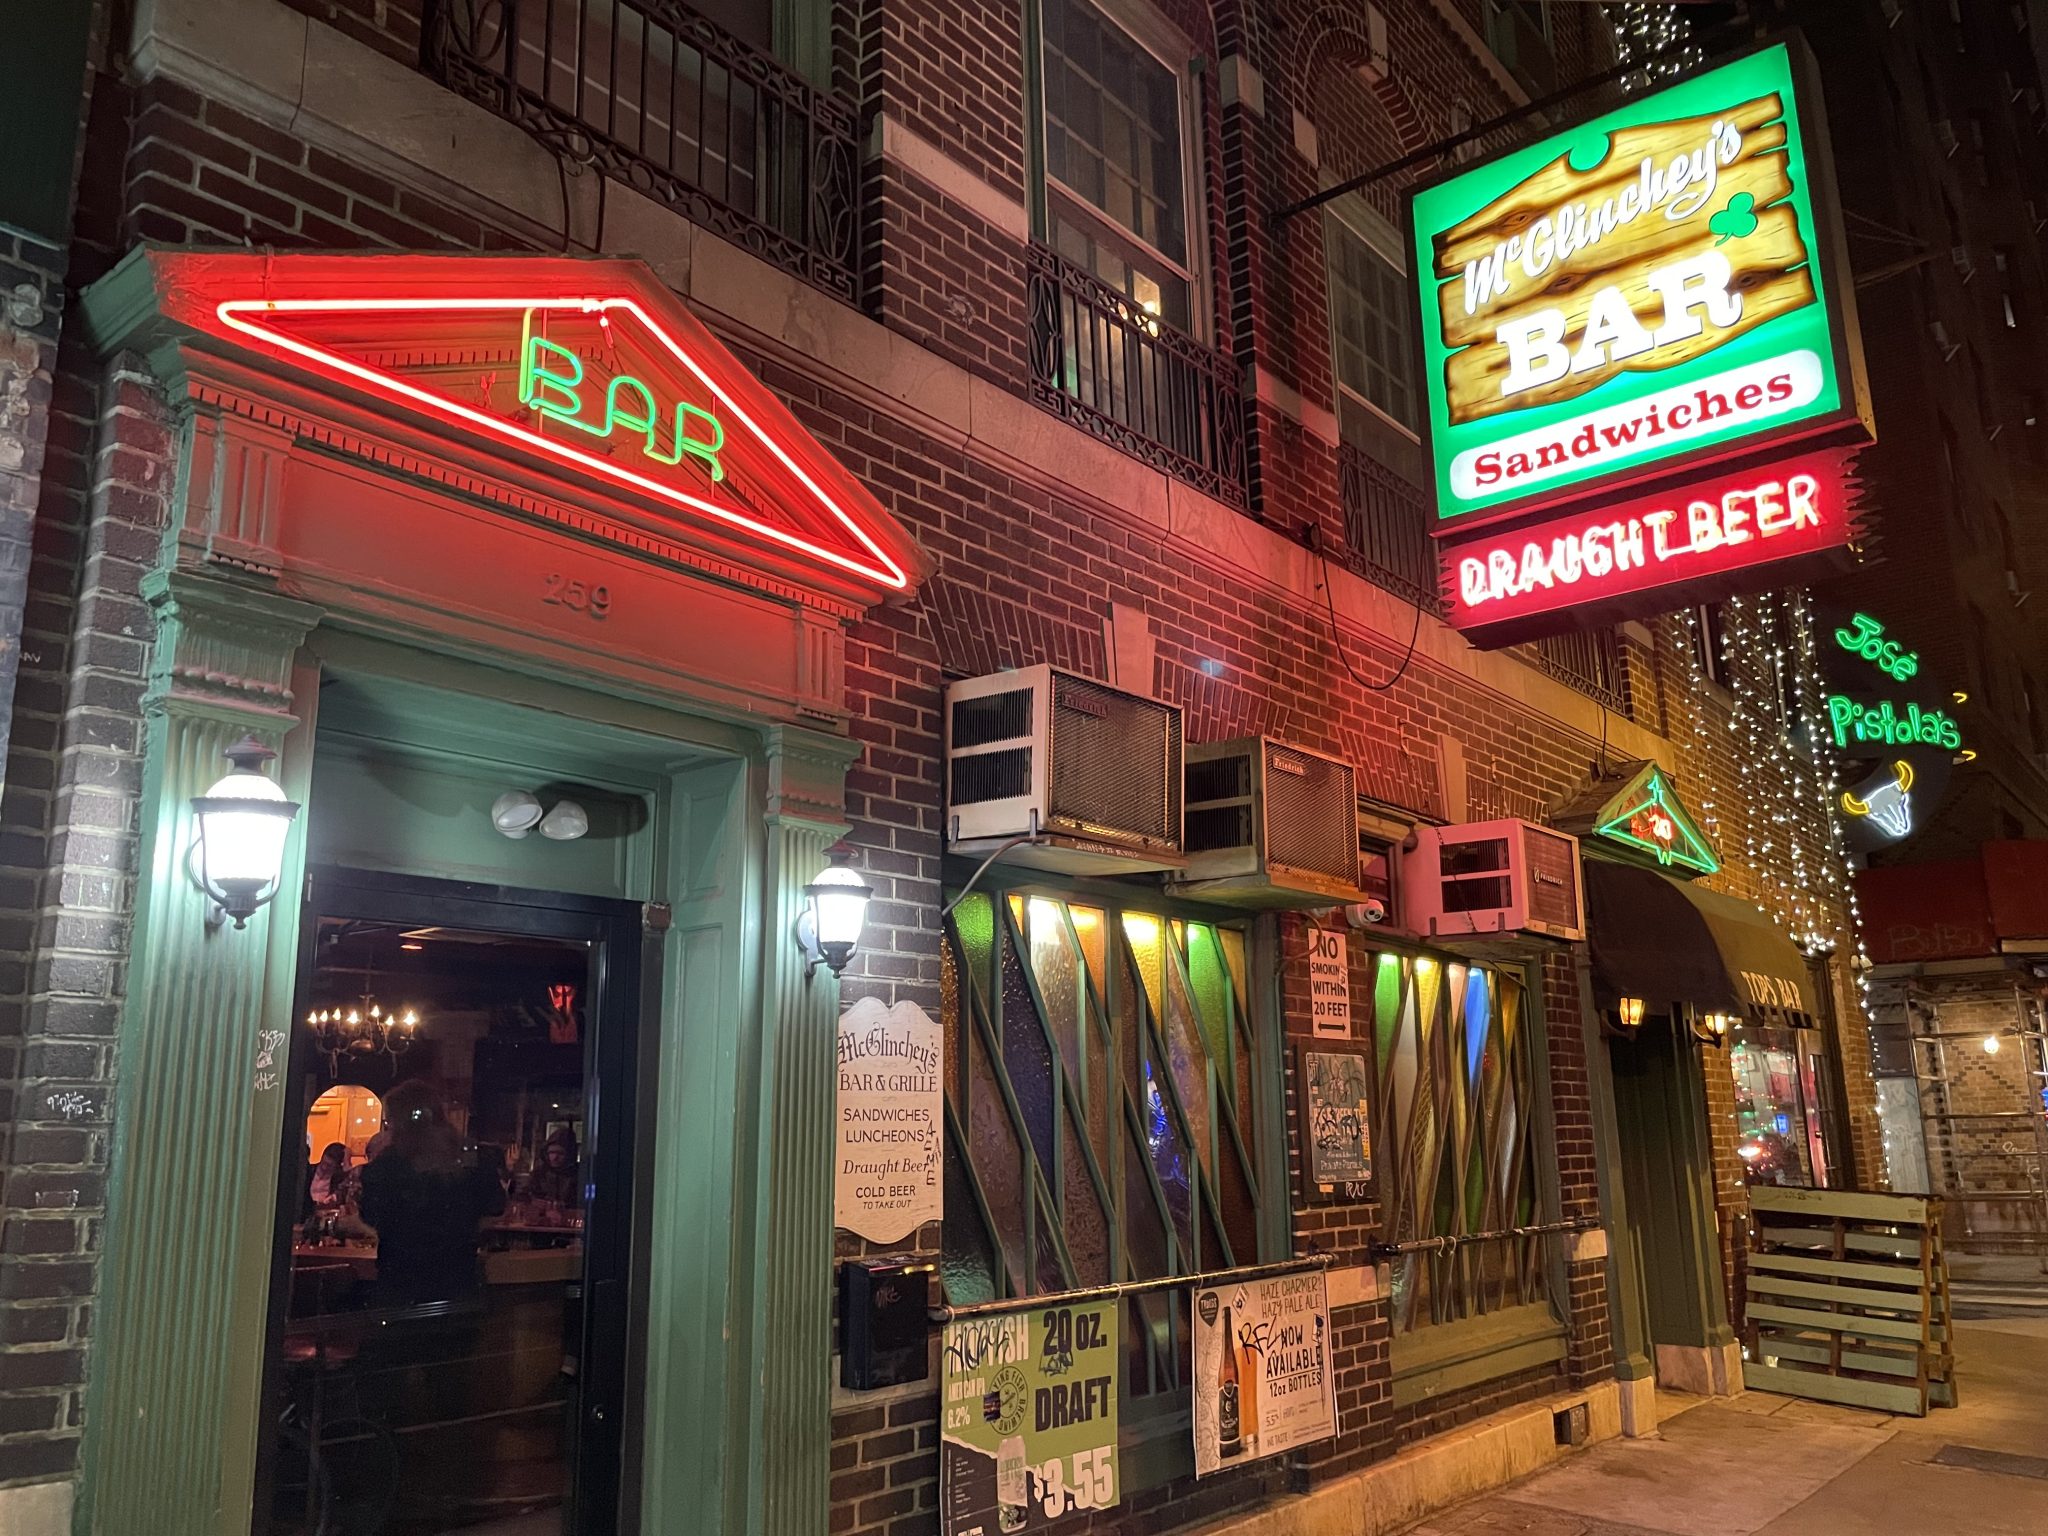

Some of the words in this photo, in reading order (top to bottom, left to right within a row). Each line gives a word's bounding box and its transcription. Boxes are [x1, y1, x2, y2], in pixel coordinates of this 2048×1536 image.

[1463, 120, 1742, 314] McGlinchey's
[1496, 249, 1743, 396] BAR
[519, 334, 724, 481] BAR
[1474, 371, 1794, 487] Sandwiches
[1460, 510, 1677, 606] DRAUGHT
[1689, 474, 1821, 553] BEER
[542, 574, 612, 619] 259
[1828, 695, 1961, 749] Pistola's
[1316, 935, 1338, 960] NO
[1311, 962, 1341, 976] SMOKIN
[1313, 980, 1347, 997] WITHIN
[1314, 1001, 1326, 1016] 20
[1327, 1002, 1348, 1017] FEET
[838, 1021, 940, 1074] McGlinchey's
[839, 1073, 872, 1092] BAR
[876, 1074, 886, 1092] &
[888, 1074, 938, 1094] GRILLE
[843, 1108, 930, 1122] SANDWICHES
[845, 1129, 925, 1143] LUNCHEONS
[843, 1158, 901, 1181] Draught
[902, 1157, 929, 1174] Beer
[855, 1186, 886, 1199] COLD
[889, 1184, 916, 1197] BEER
[863, 1201, 874, 1210] TO
[875, 1200, 895, 1210] TAKE
[896, 1199, 912, 1209] OUT
[1260, 1281, 1280, 1301] HAZE
[1281, 1276, 1318, 1297] CHARMER
[1261, 1300, 1283, 1319] HAZY
[1284, 1295, 1304, 1315] PALE
[1305, 1294, 1321, 1311] ALE
[1043, 1308, 1073, 1356] 20
[1076, 1312, 1108, 1351] OZ.
[1281, 1325, 1304, 1350] NOW
[1266, 1345, 1323, 1380] AVAILABLE
[1269, 1380, 1287, 1398] 12oz
[1288, 1371, 1322, 1393] BOTTLES
[1035, 1375, 1112, 1433] DRAFT
[947, 1405, 971, 1429] 6.2%
[1033, 1445, 1114, 1519] $3.55
